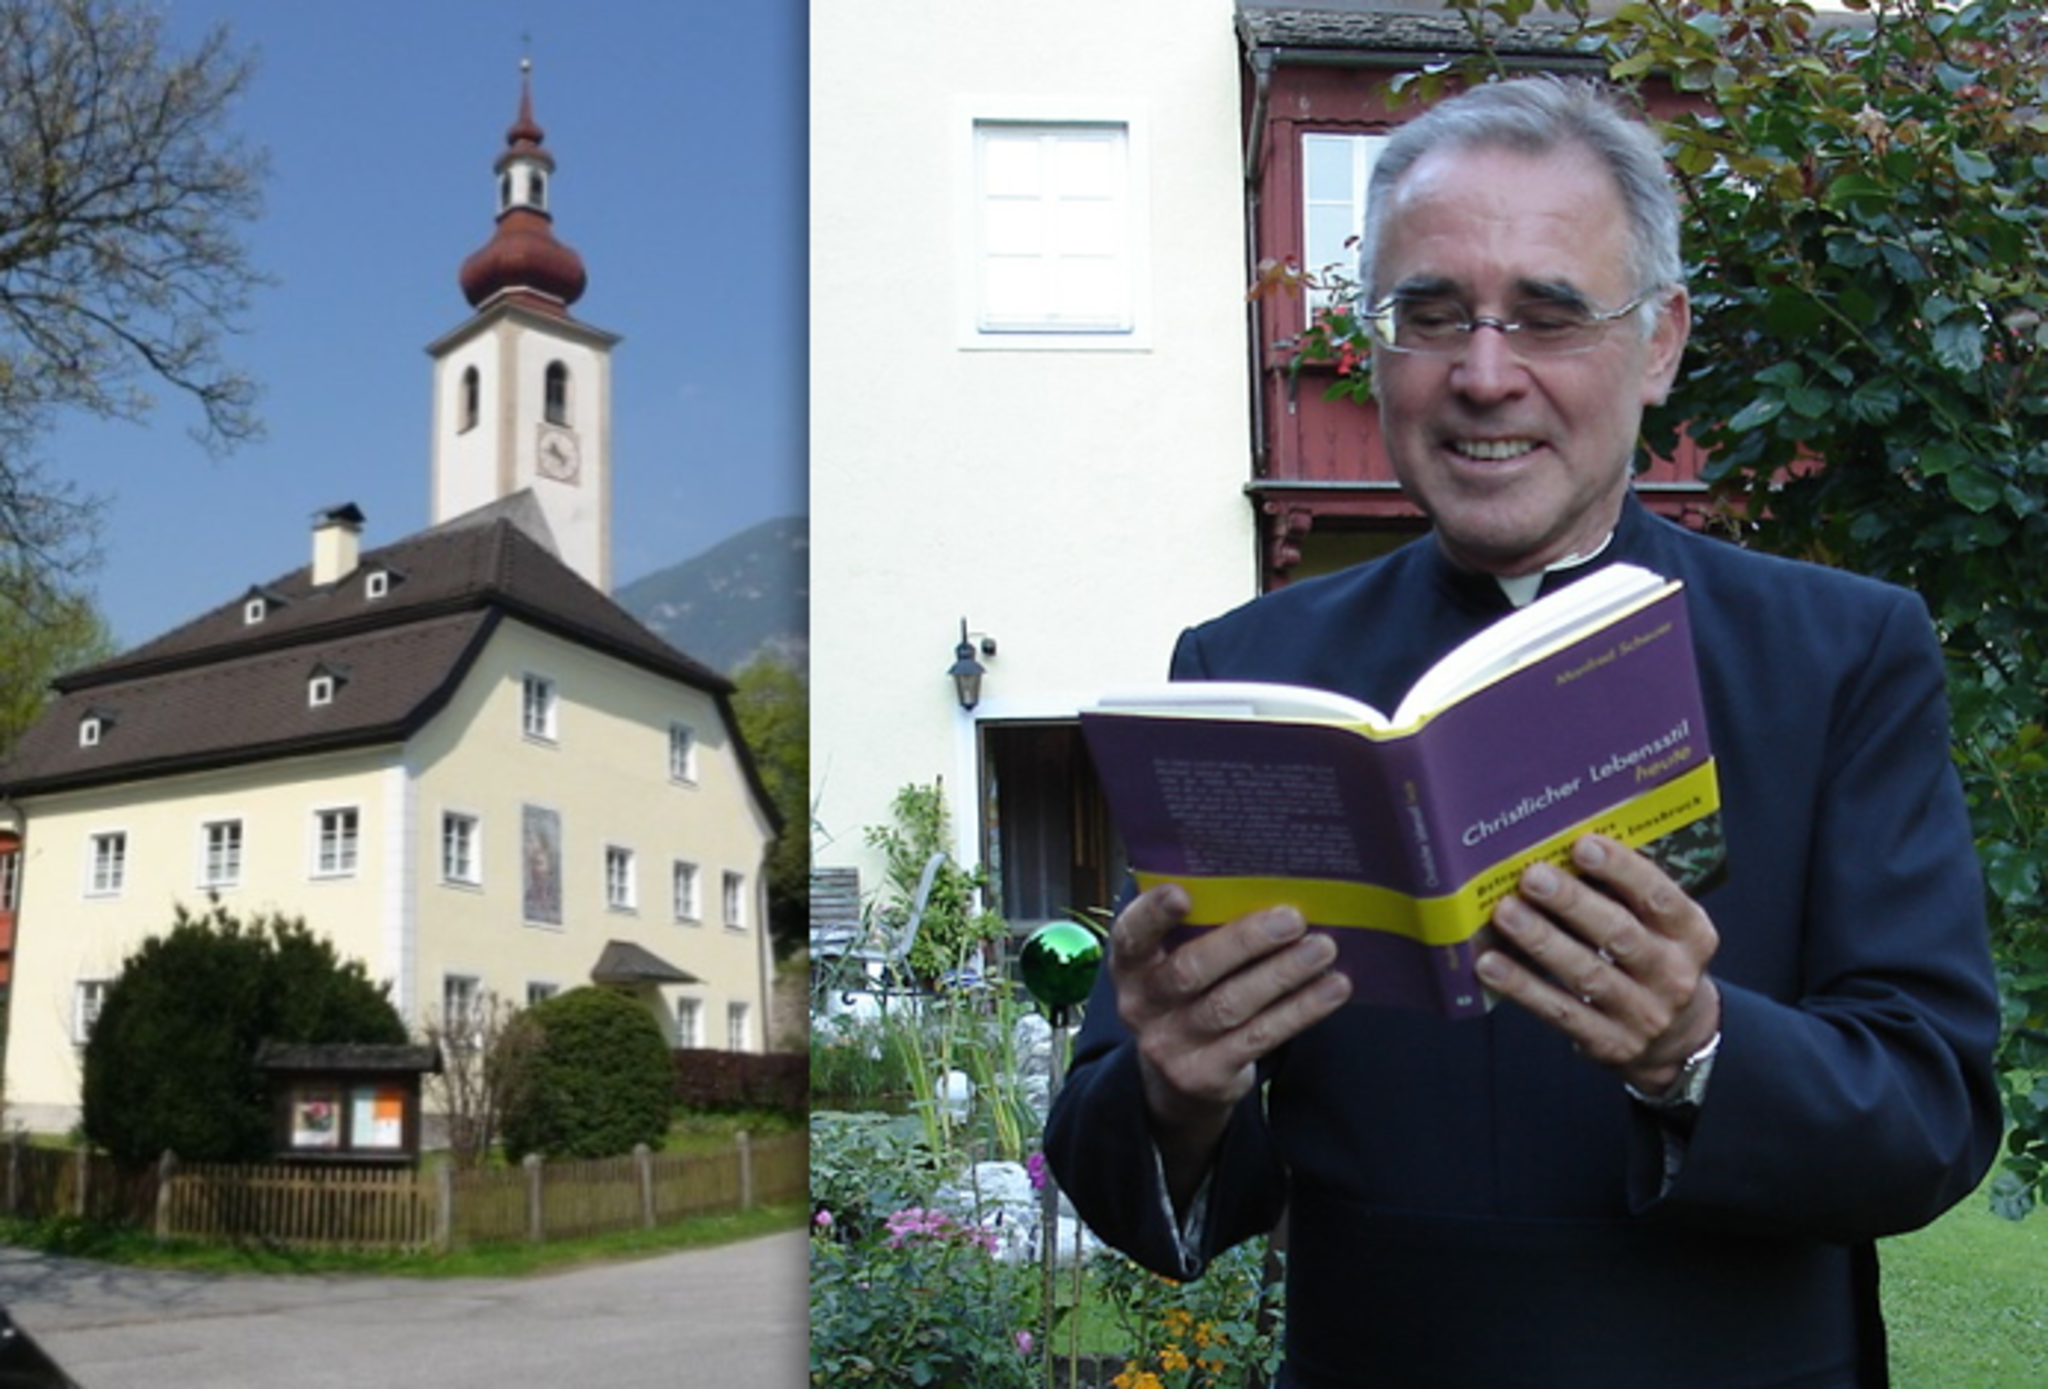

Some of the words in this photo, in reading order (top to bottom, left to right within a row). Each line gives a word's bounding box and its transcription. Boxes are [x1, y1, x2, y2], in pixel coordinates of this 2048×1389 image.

[1461, 777, 1581, 846] Christlicher
[1589, 718, 1689, 783] Lebensstil
[1635, 746, 1692, 783] heute
